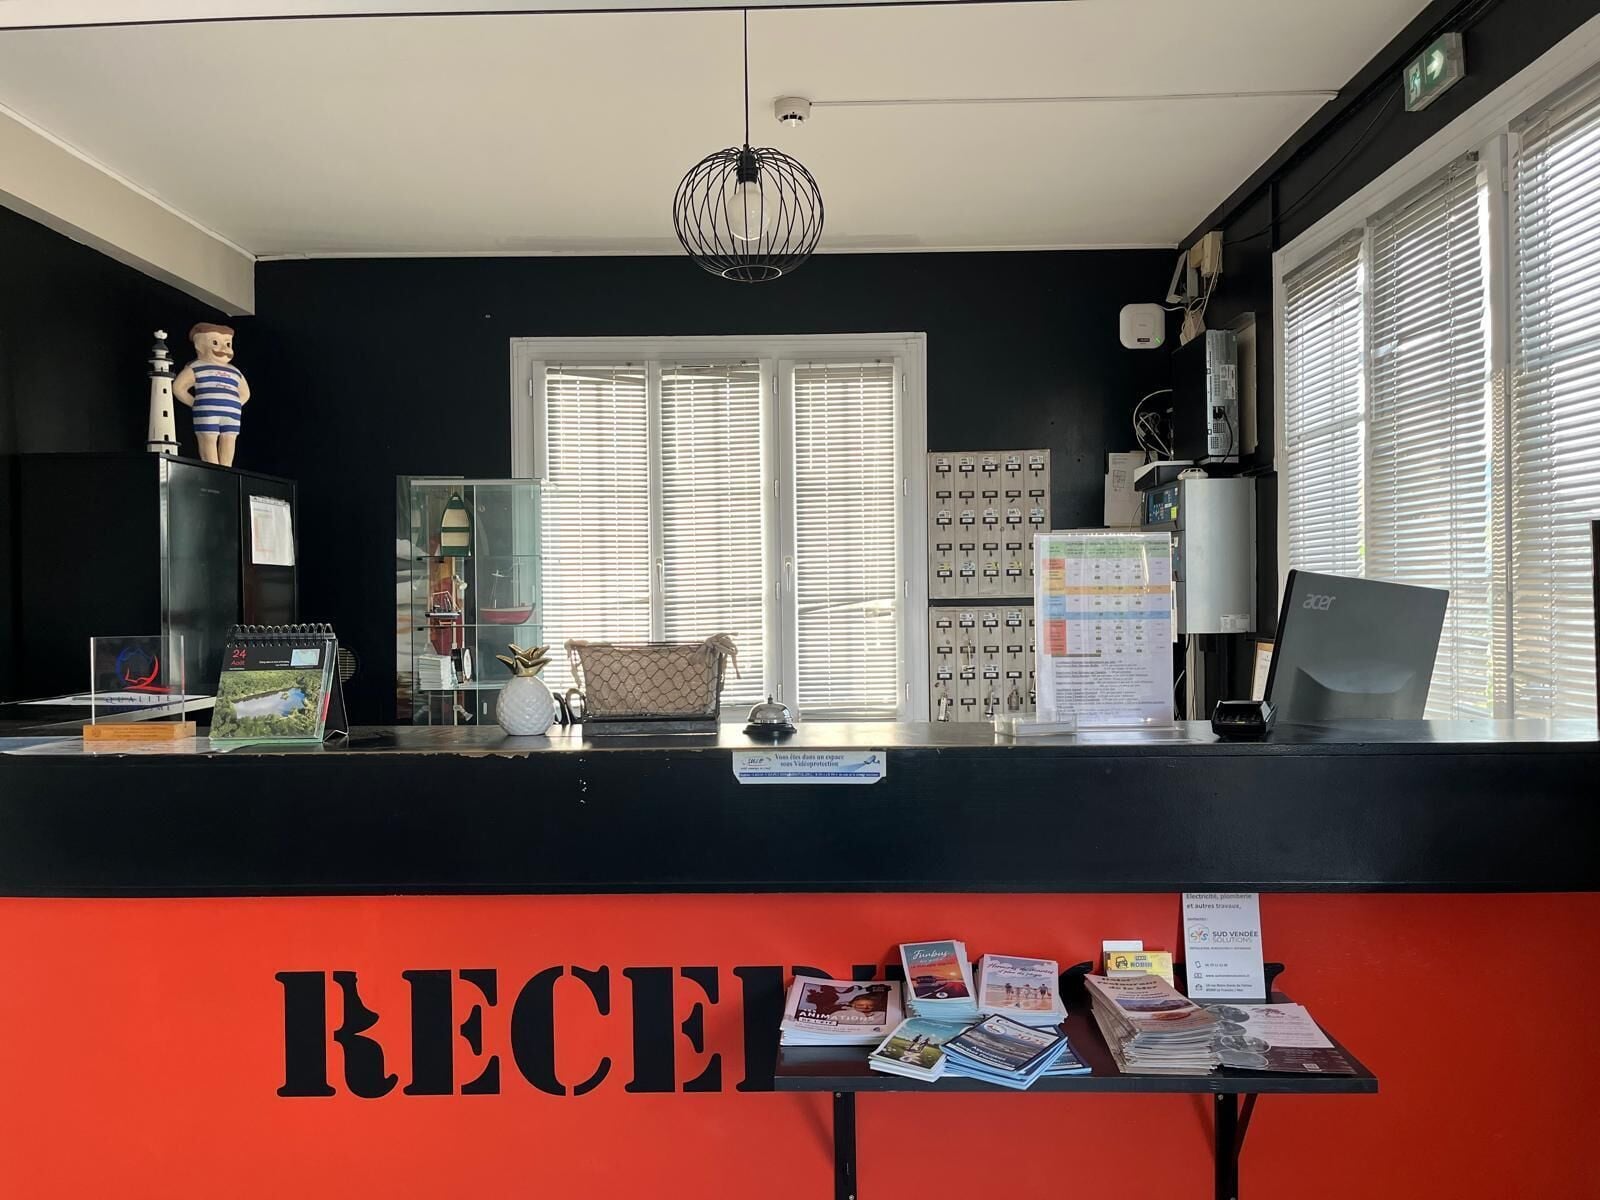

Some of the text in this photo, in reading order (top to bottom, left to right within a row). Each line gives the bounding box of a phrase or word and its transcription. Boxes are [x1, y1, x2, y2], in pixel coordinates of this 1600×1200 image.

[1302, 592, 1336, 611] acer
[231, 648, 247, 659] 24
[825, 754, 845, 762] espace
[798, 1011, 875, 1022] ANIMATIONS
